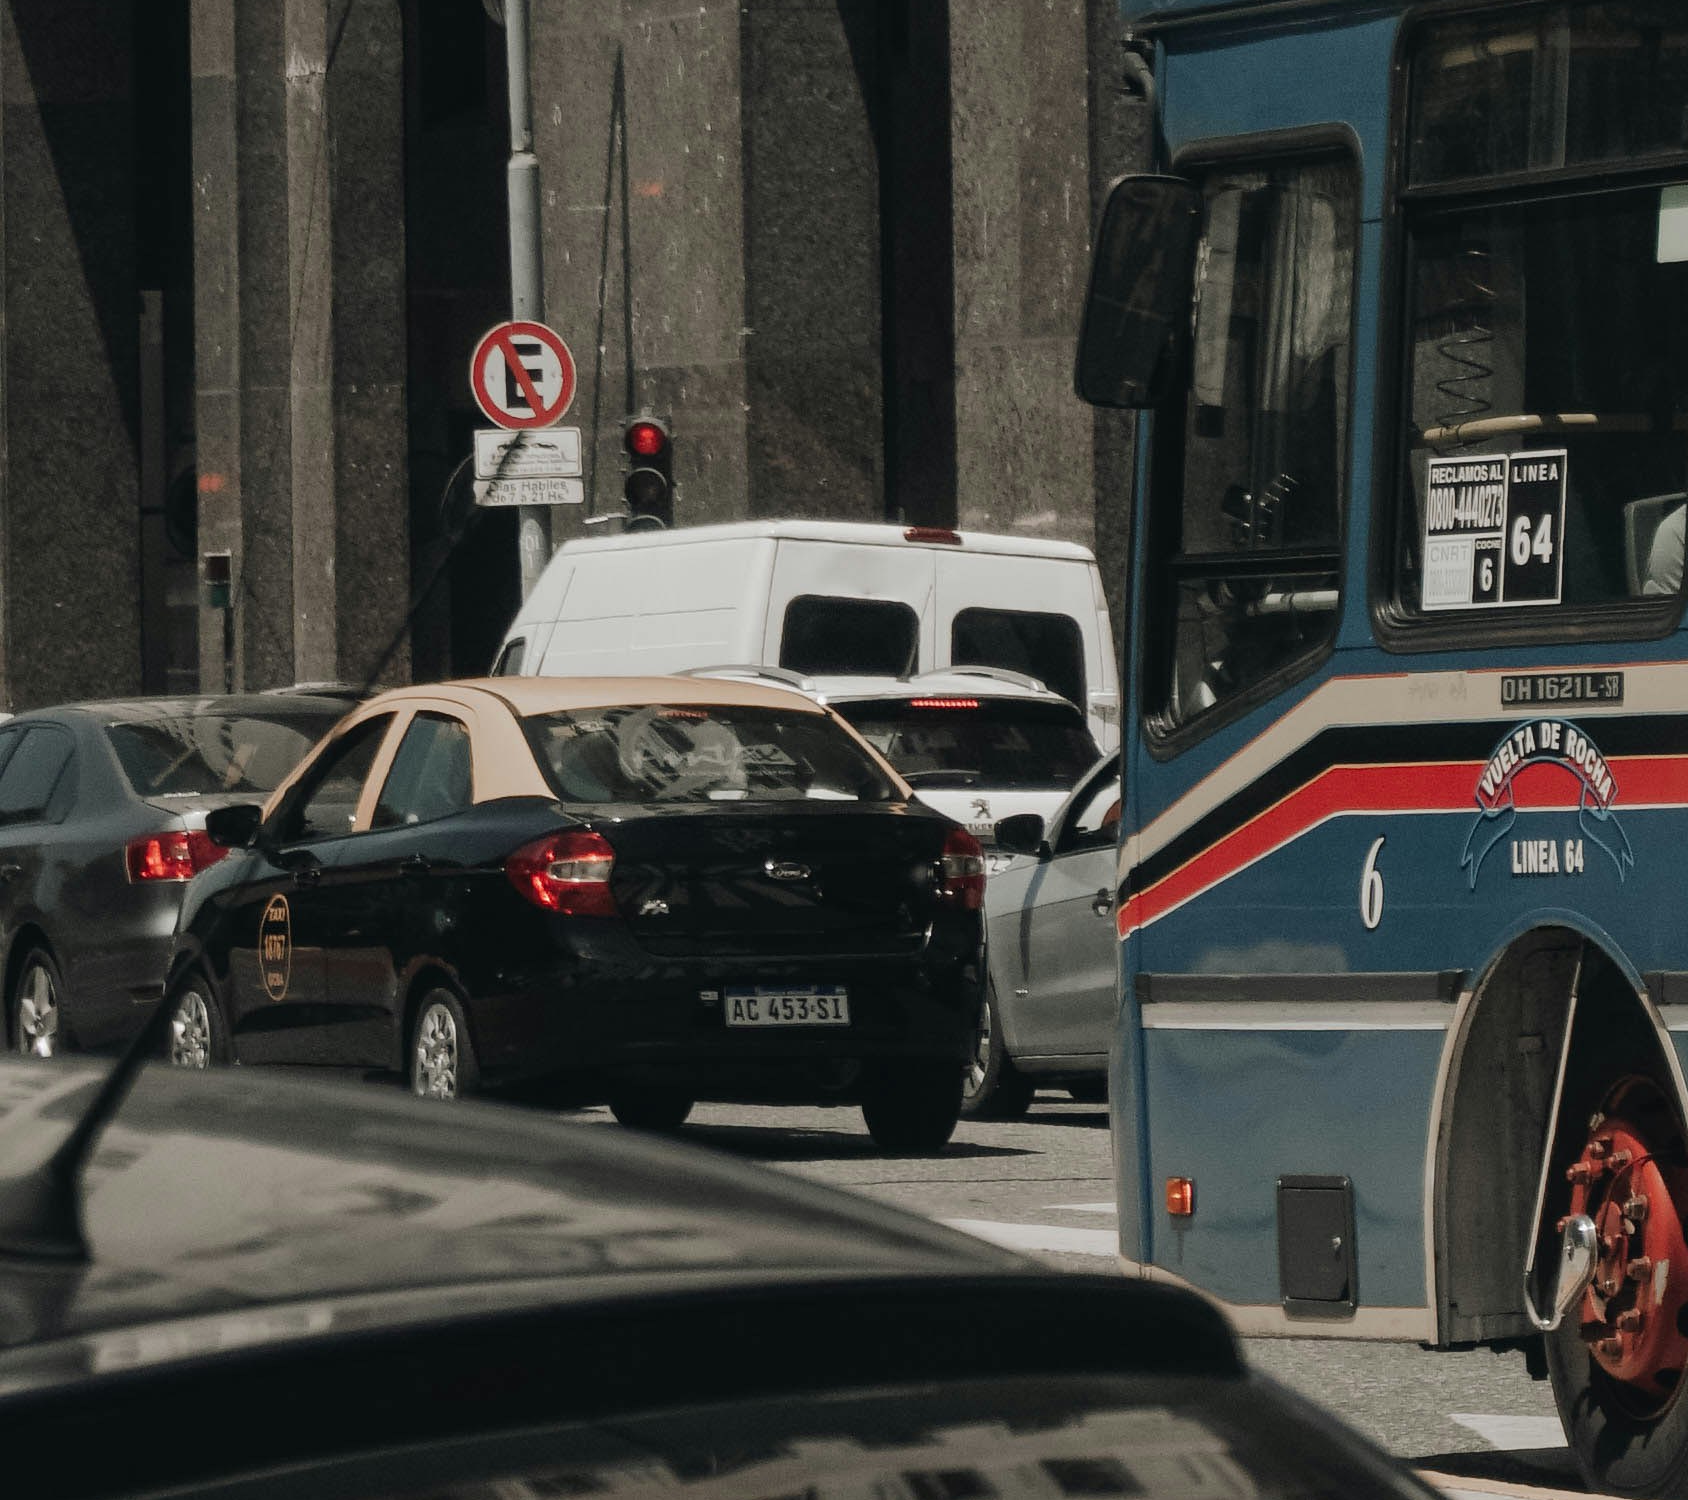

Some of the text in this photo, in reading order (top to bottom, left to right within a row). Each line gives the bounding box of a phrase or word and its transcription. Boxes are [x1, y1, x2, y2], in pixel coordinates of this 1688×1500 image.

[504, 343, 543, 409] E
[1431, 464, 1504, 484] RECLAMOS AL
[1513, 463, 1559, 483] LINEA
[1511, 514, 1553, 566] 64
[1479, 558, 1493, 592] 6
[1503, 678, 1532, 701] OH
[1481, 722, 1612, 802] VUELTA DE ROCHA
[1512, 838, 1585, 874] LINEA 64
[1361, 835, 1386, 929] 6
[733, 997, 843, 1021] AC 453 SI
